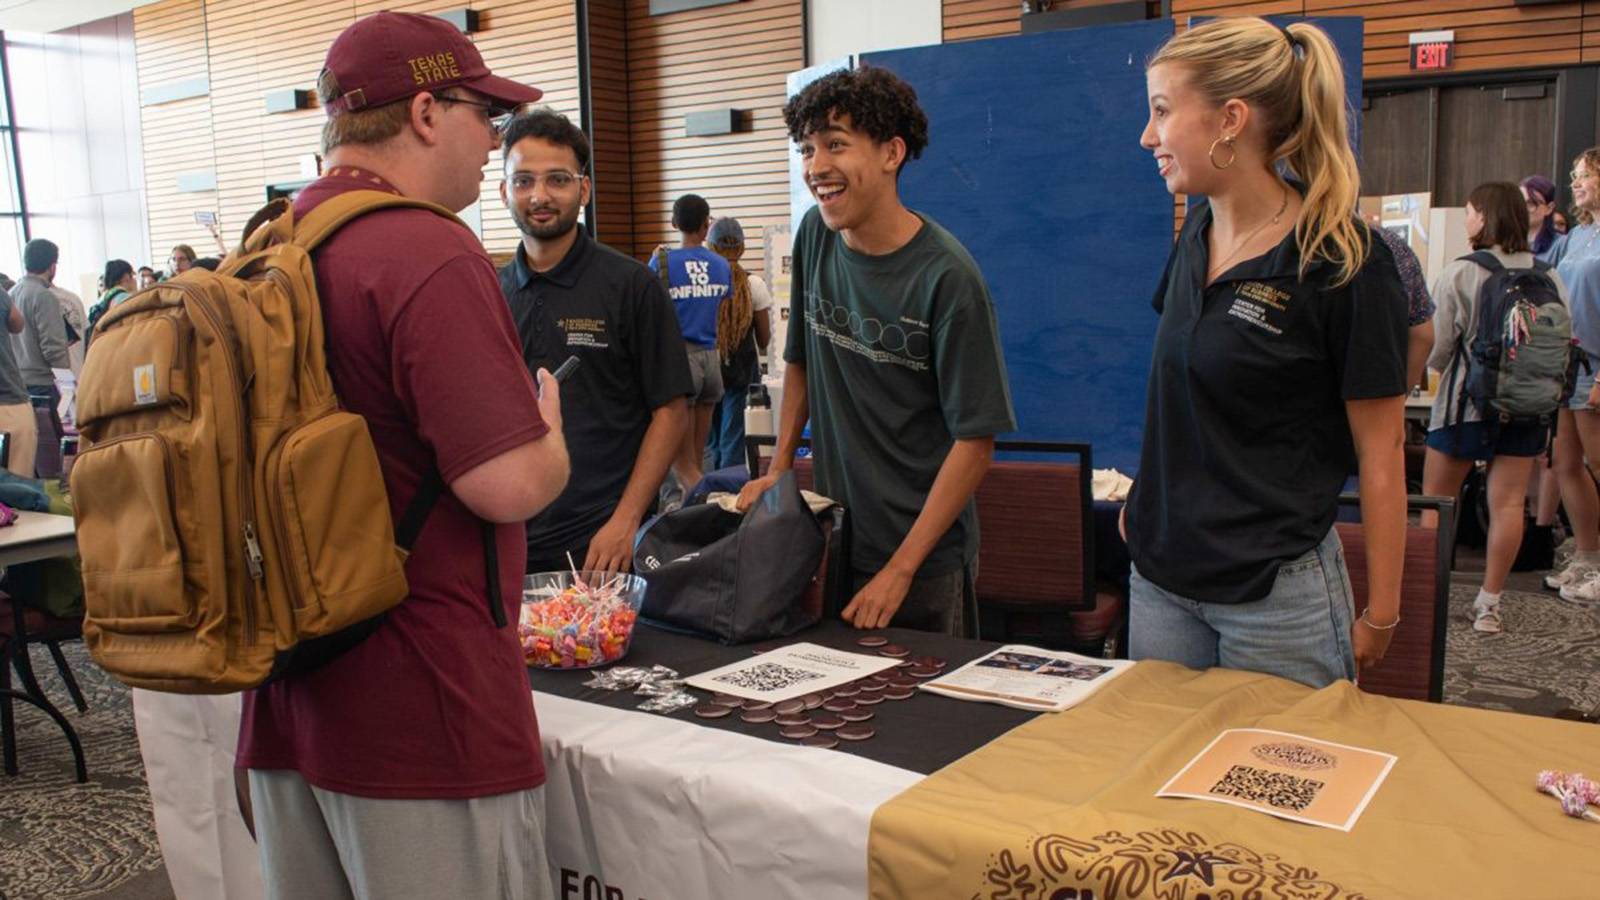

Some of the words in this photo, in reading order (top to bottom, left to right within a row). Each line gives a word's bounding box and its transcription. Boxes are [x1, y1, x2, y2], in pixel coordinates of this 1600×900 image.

[408, 51, 455, 72] TEXAS
[1416, 43, 1448, 68] EXIT
[414, 65, 461, 85] STATE
[684, 260, 709, 274] FLY
[689, 273, 709, 286] TO
